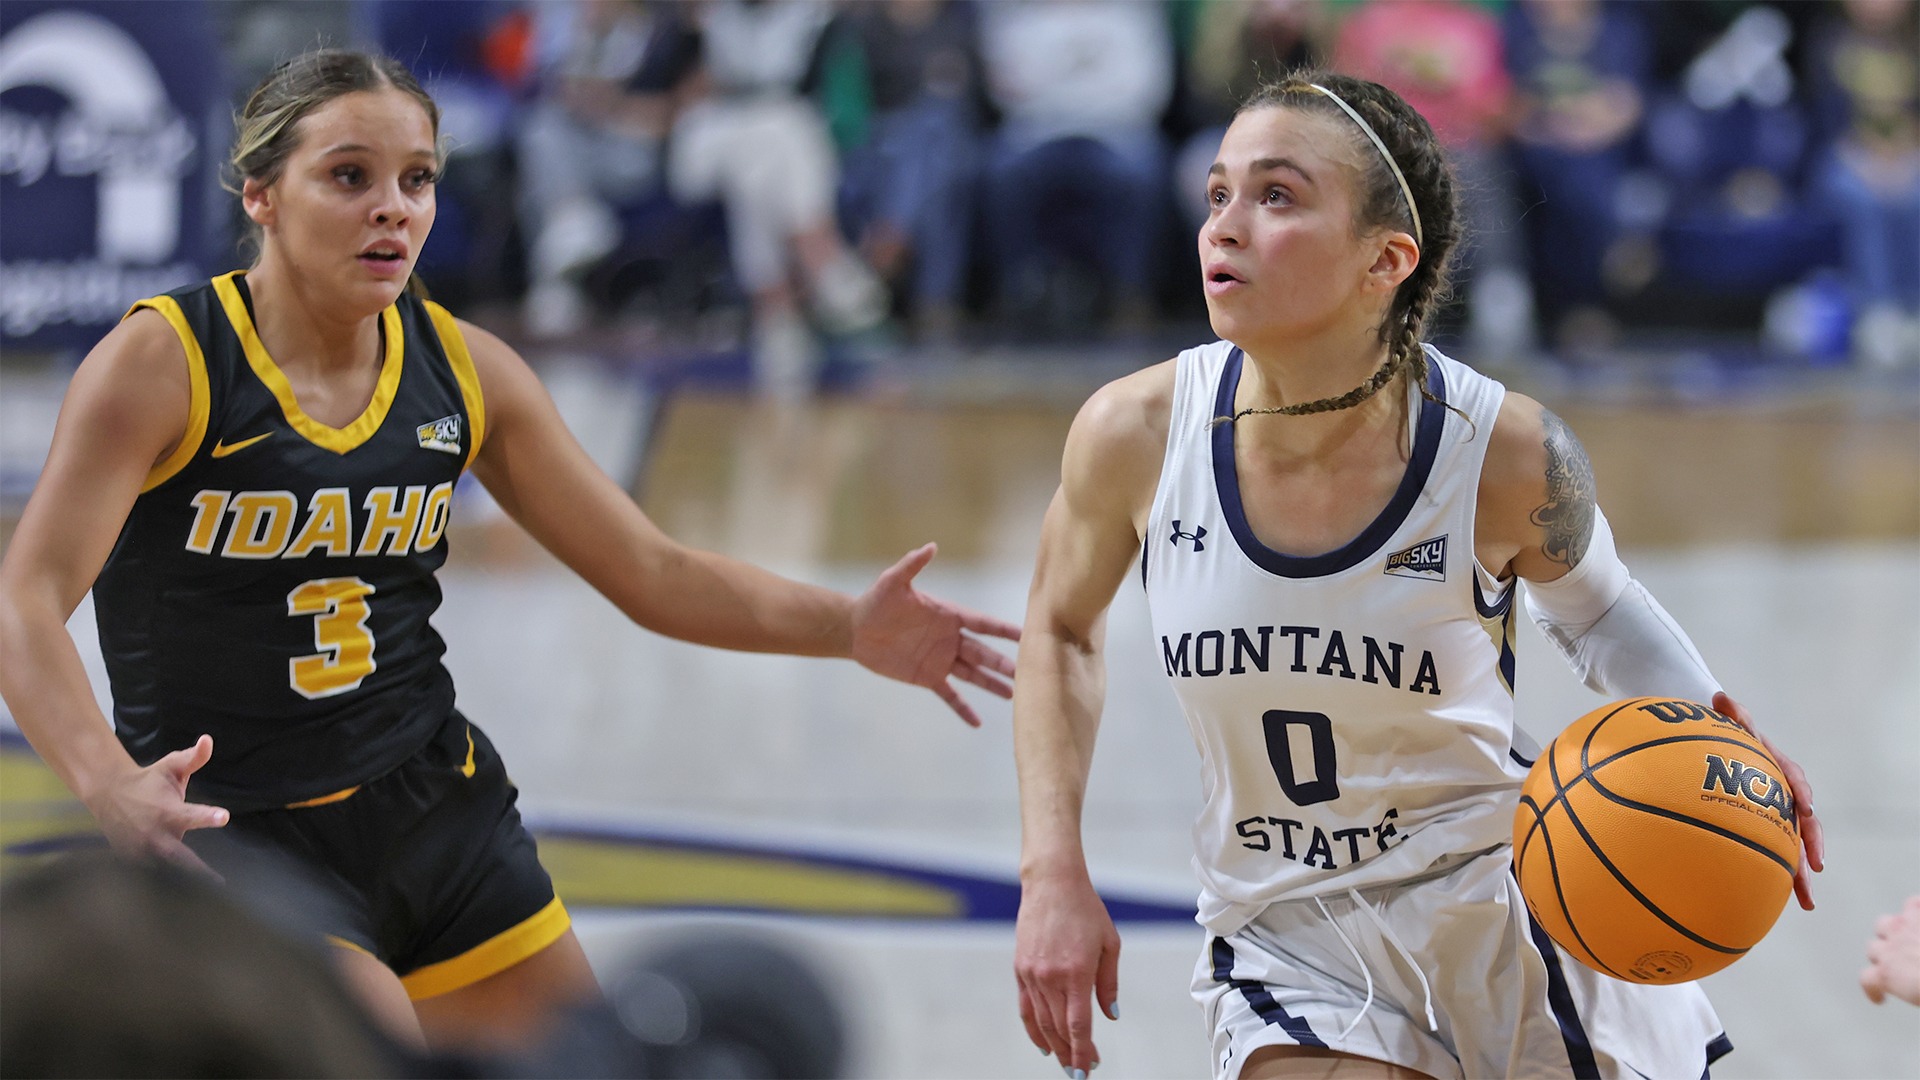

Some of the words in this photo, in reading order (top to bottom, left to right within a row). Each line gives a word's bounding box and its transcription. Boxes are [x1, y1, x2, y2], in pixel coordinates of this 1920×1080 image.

[185, 481, 453, 560] IDAHO
[286, 576, 377, 700] 3
[1161, 625, 1442, 696] MONTANA
[1261, 709, 1341, 807] 0
[1235, 807, 1410, 871] STATE
[1700, 794, 1755, 814] OFFICIAL
